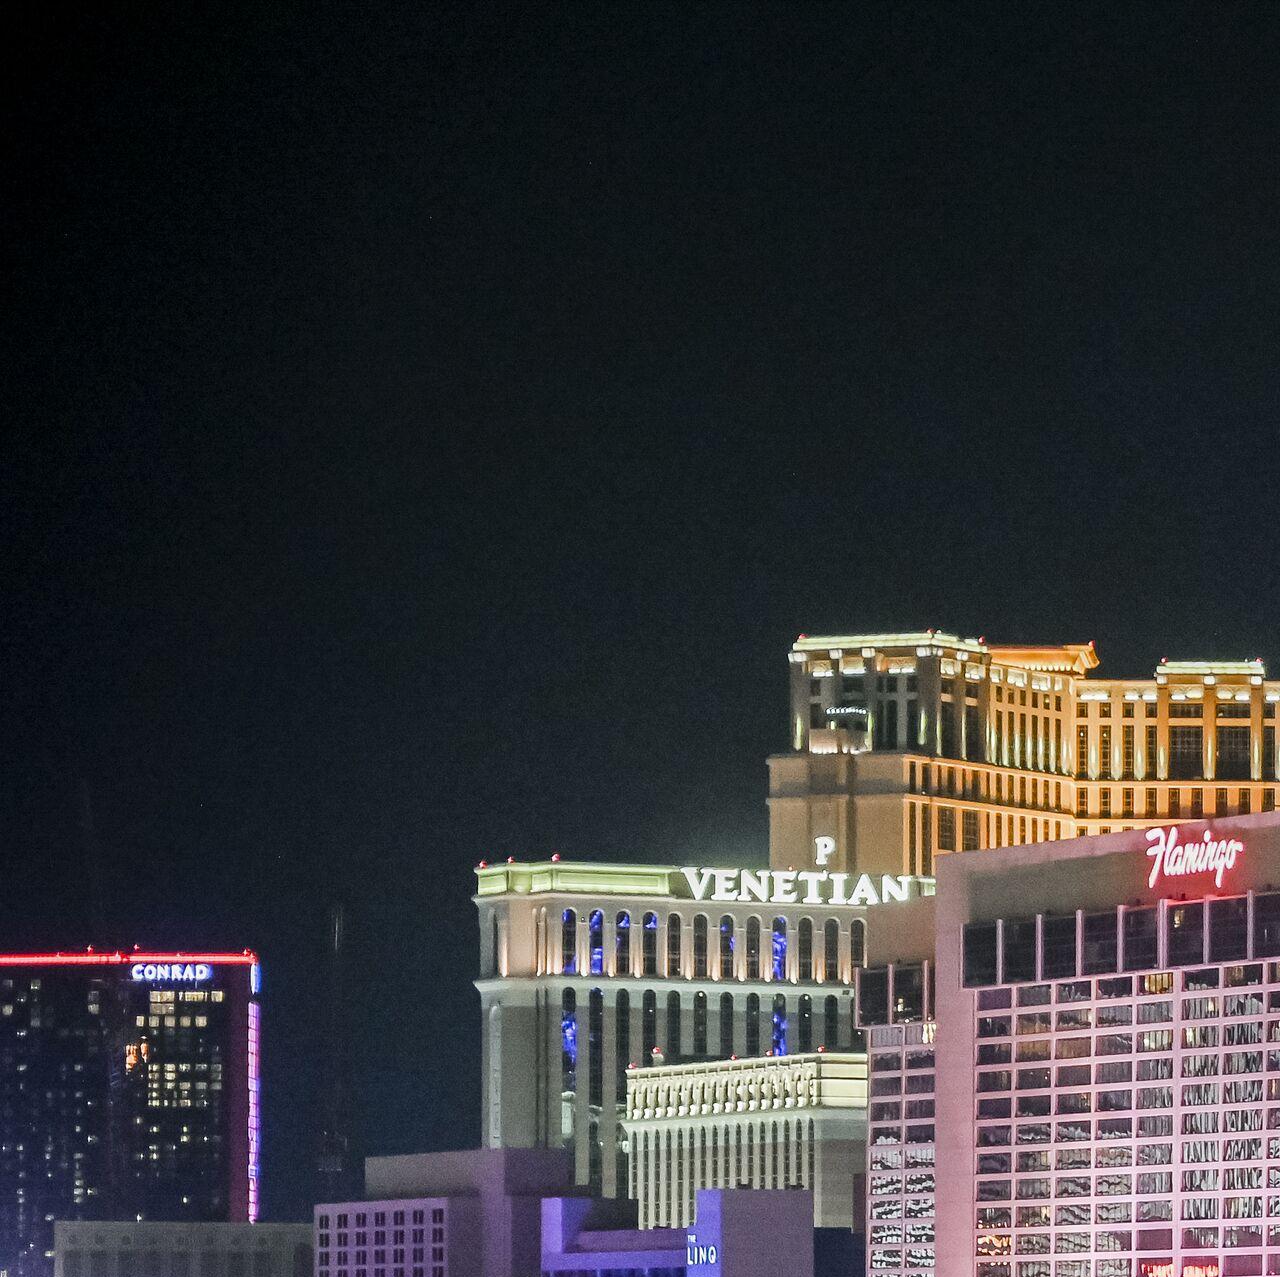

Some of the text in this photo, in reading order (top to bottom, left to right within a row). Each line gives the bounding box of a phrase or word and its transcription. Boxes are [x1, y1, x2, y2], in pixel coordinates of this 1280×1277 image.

[1144, 826, 1244, 889] Flamingo
[679, 866, 913, 906] VENETIAN
[131, 963, 210, 981] CONRAD
[687, 1245, 717, 1265] LINQ
